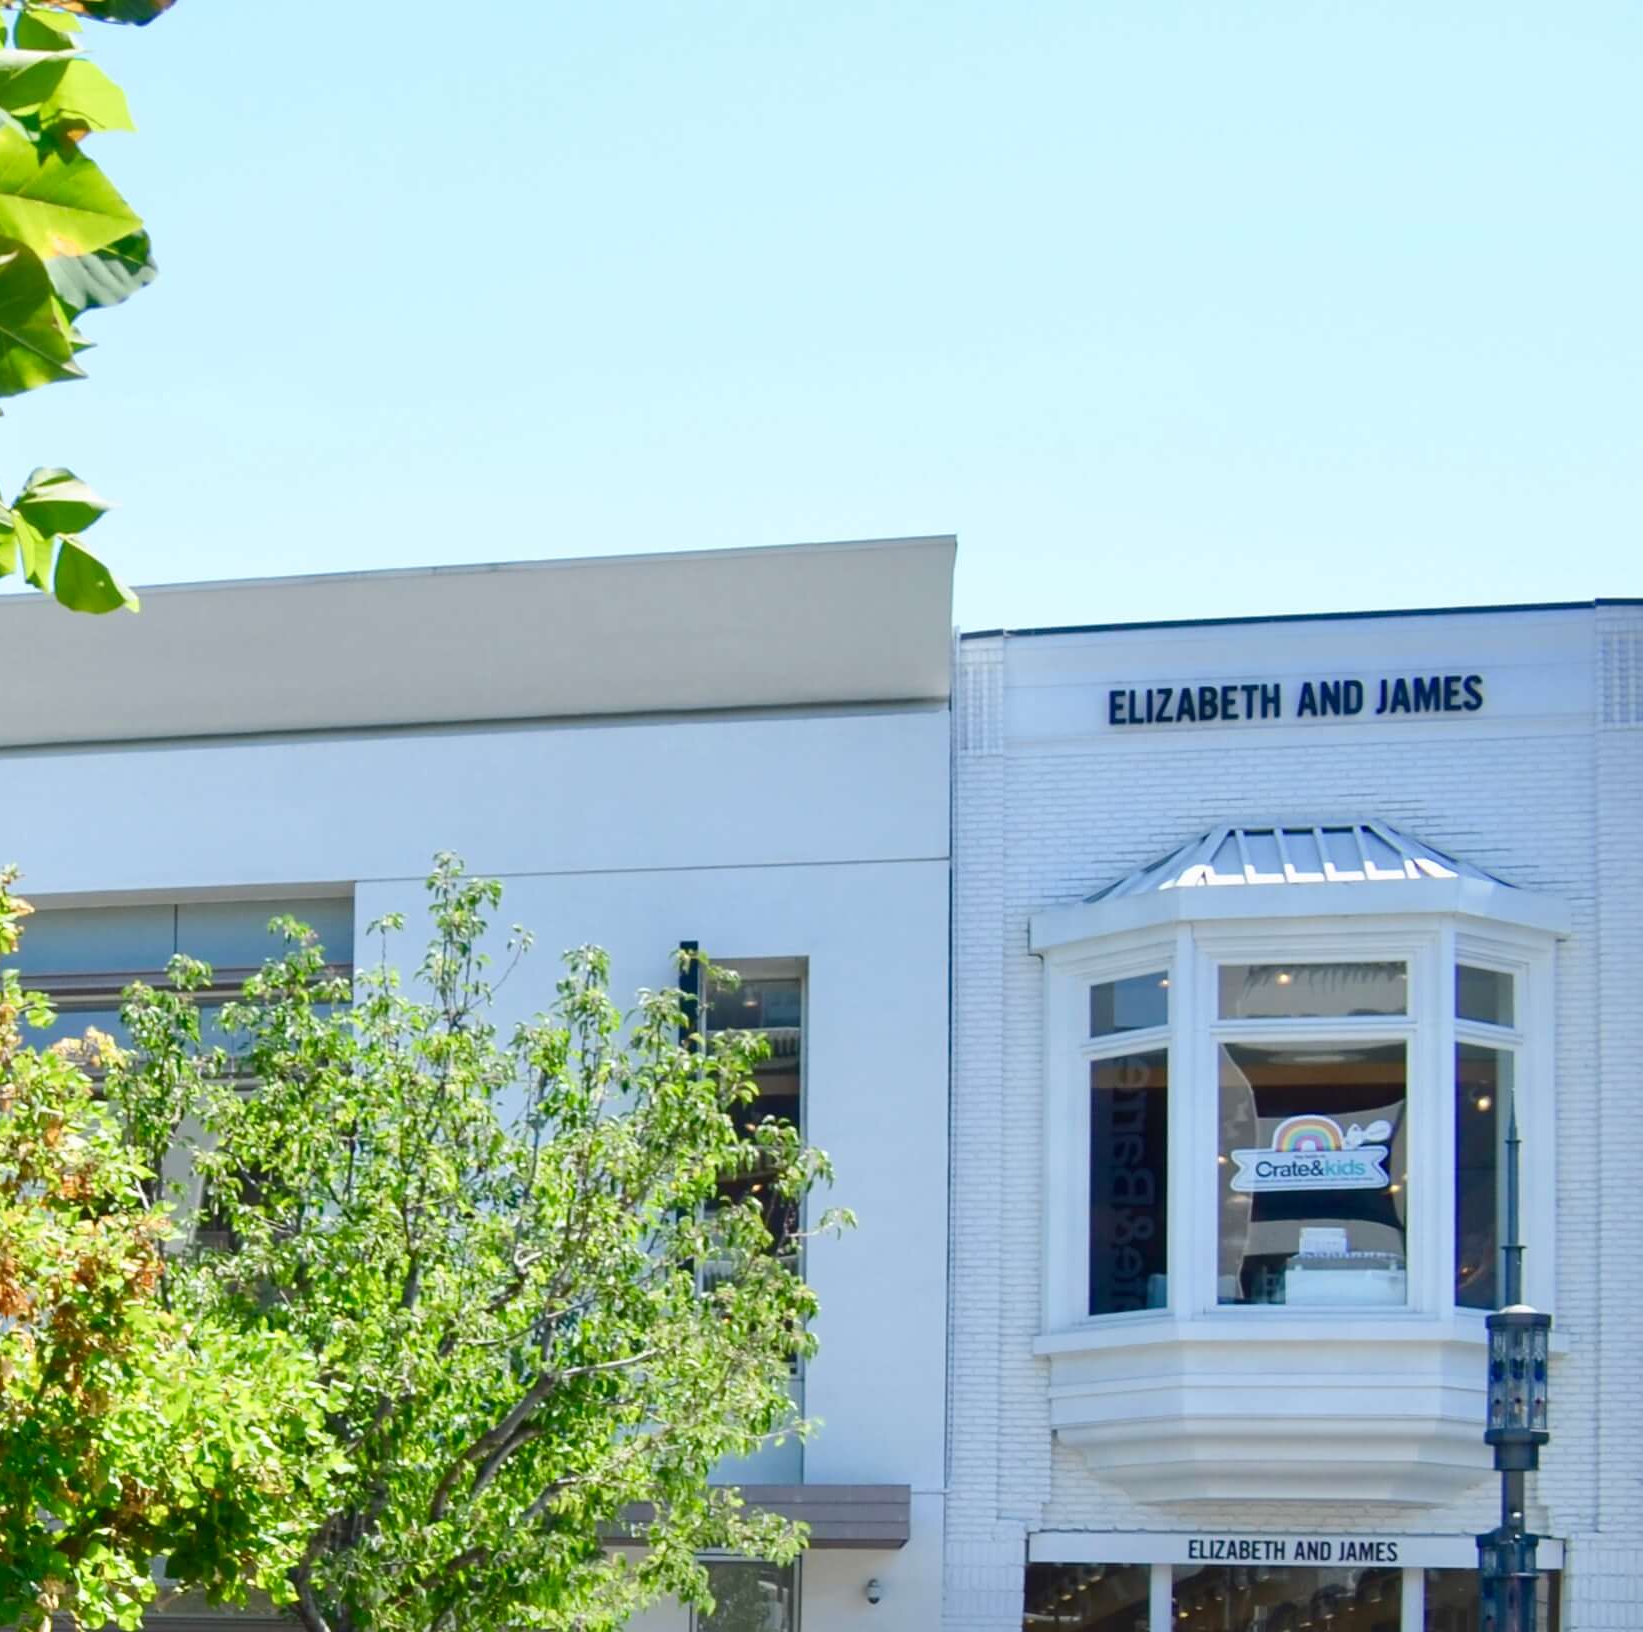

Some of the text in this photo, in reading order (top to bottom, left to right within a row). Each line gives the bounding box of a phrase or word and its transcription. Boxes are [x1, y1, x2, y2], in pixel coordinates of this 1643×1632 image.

[1108, 674, 1484, 725] ELIZABETH AND JAMES
[1255, 1160, 1366, 1178] Crate&kids
[1187, 1539, 1399, 1562] ELIZABETH AND JAMES
